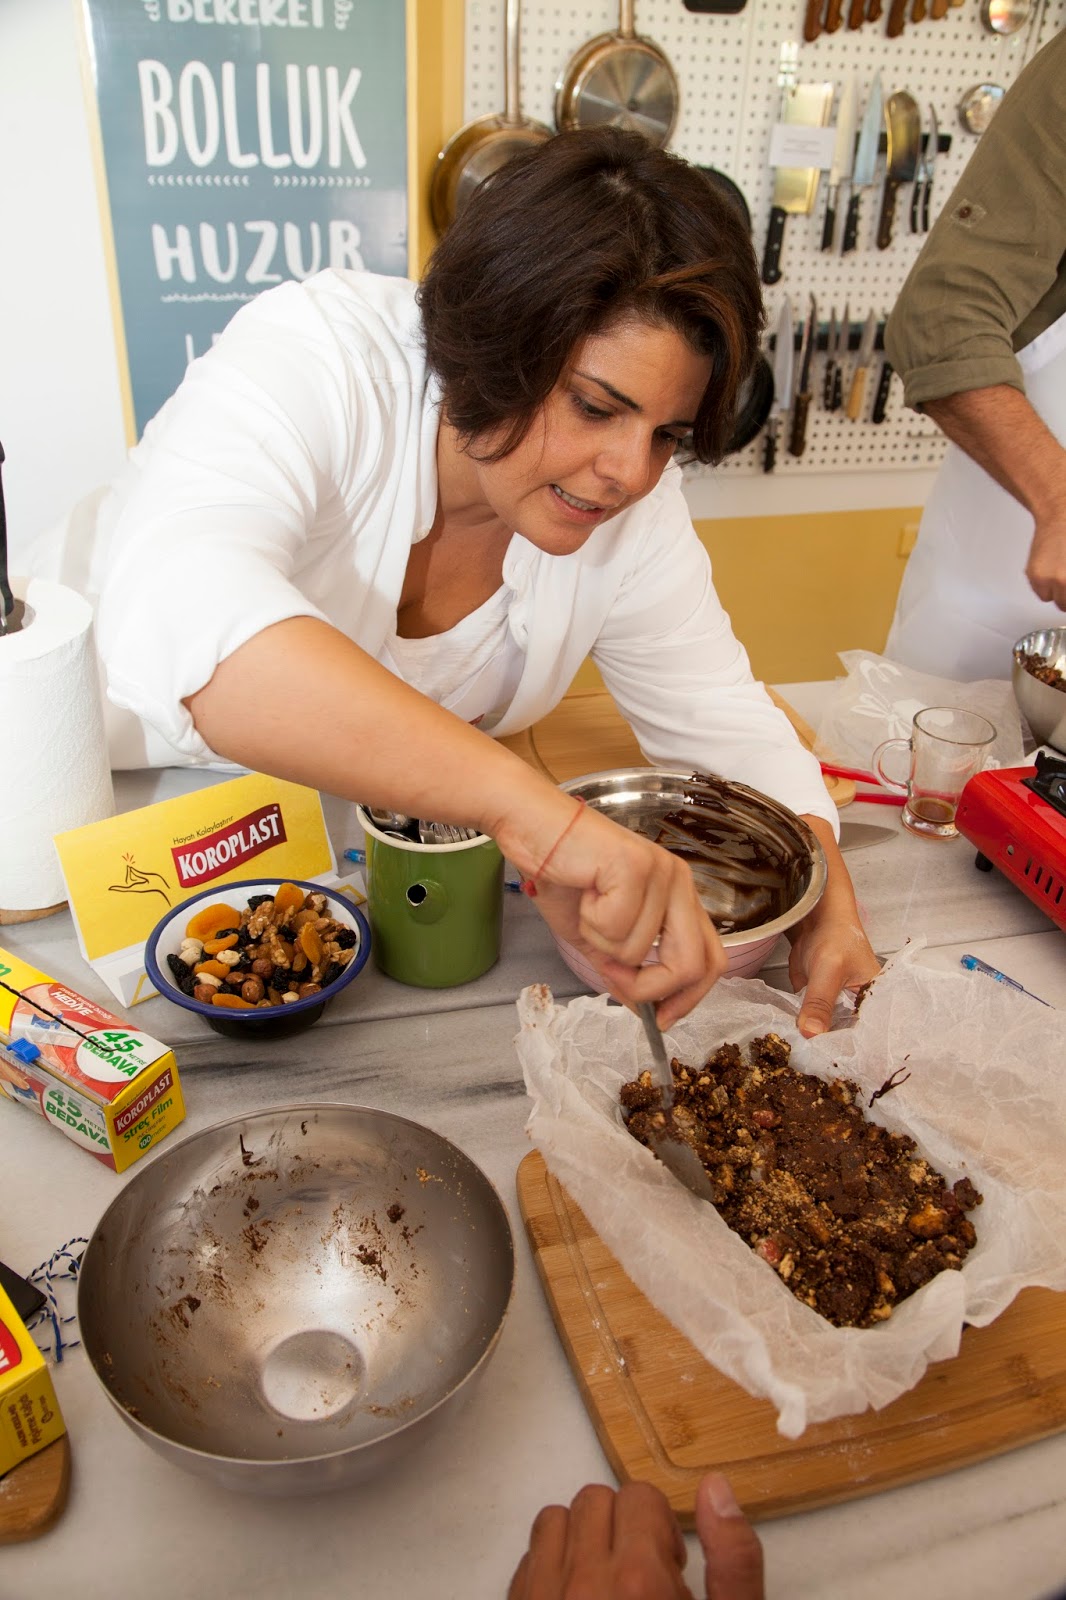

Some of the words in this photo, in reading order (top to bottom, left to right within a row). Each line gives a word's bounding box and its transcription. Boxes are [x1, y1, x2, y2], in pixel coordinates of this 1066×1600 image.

[137, 59, 367, 169] BOLLUK
[152, 220, 369, 283] HUZUR
[178, 813, 280, 880] KOROPLAST
[50, 991, 93, 1016] HEDİYE
[82, 1035, 138, 1077] BEDAVA
[103, 1032, 143, 1053] 45
[48, 1089, 82, 1117] 45
[116, 1073, 170, 1131] KOROPLAST
[124, 1117, 150, 1143] Streç
[152, 1098, 173, 1120] Film
[46, 1101, 110, 1149] BEDAVA
[140, 1135, 151, 1148] 100
